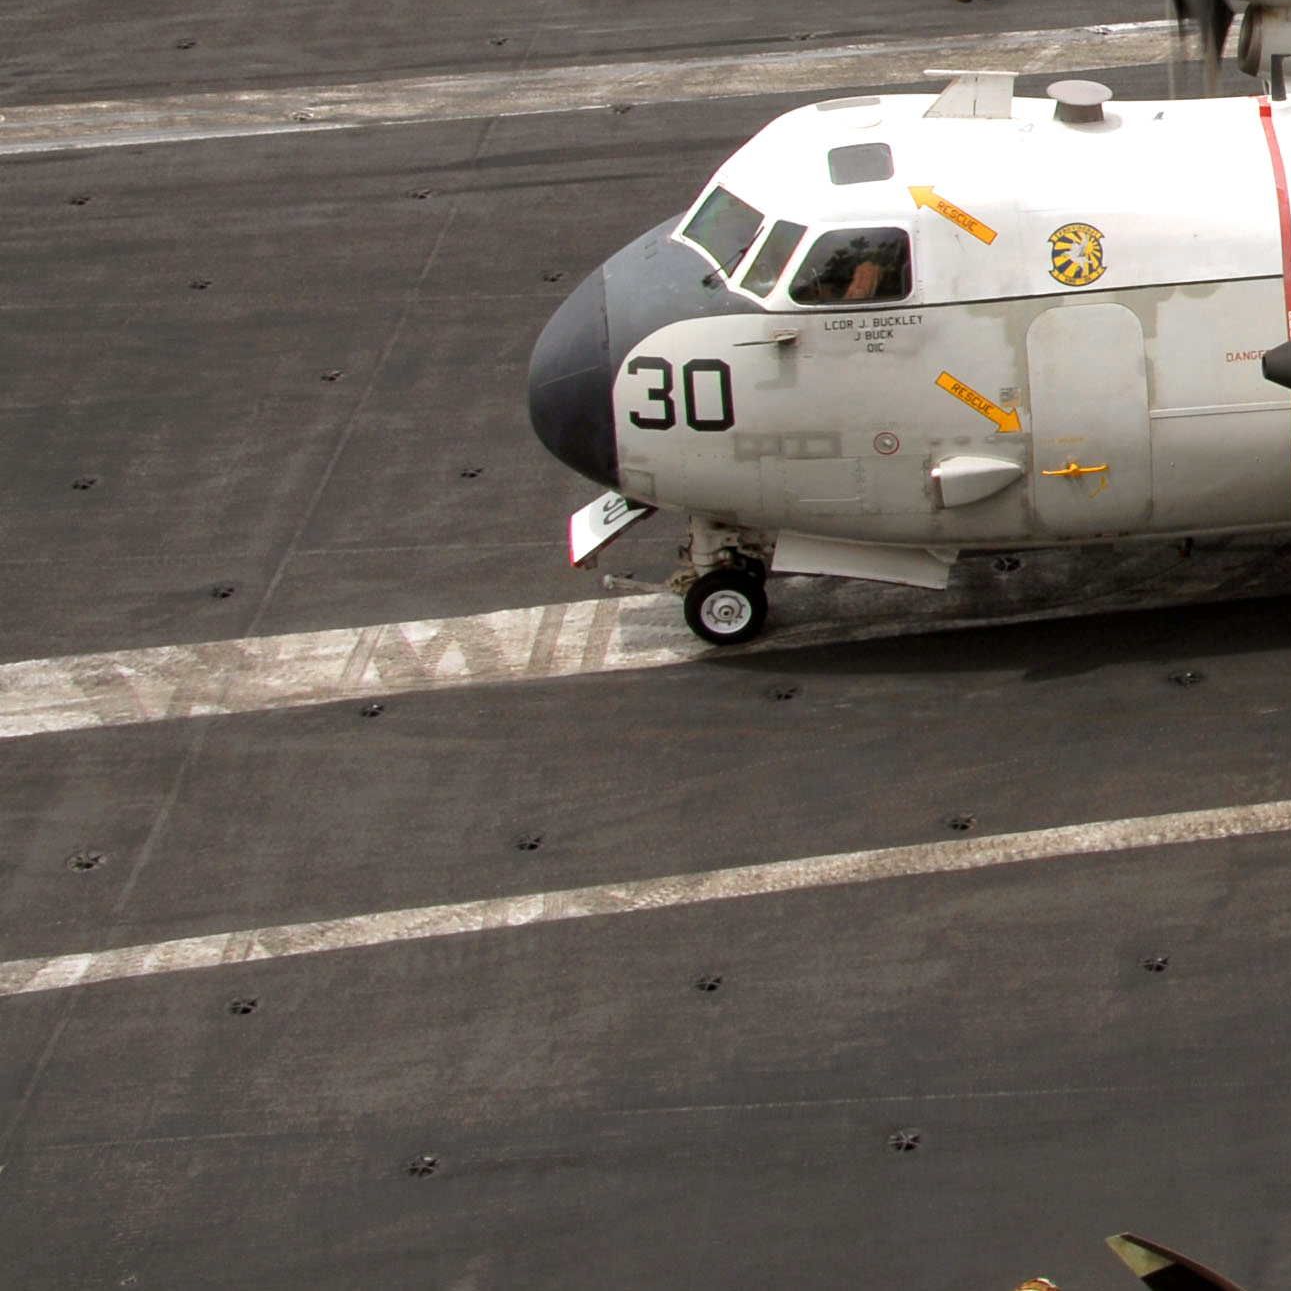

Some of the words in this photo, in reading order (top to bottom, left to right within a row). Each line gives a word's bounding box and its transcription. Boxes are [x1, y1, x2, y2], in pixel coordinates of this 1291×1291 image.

[937, 200, 977, 232] RESCUE
[872, 314, 923, 328] BUCKLEY
[864, 329, 894, 341] BUCK
[1225, 349, 1265, 363] DANGE
[627, 356, 735, 432] 30
[950, 382, 994, 415] RESCUE
